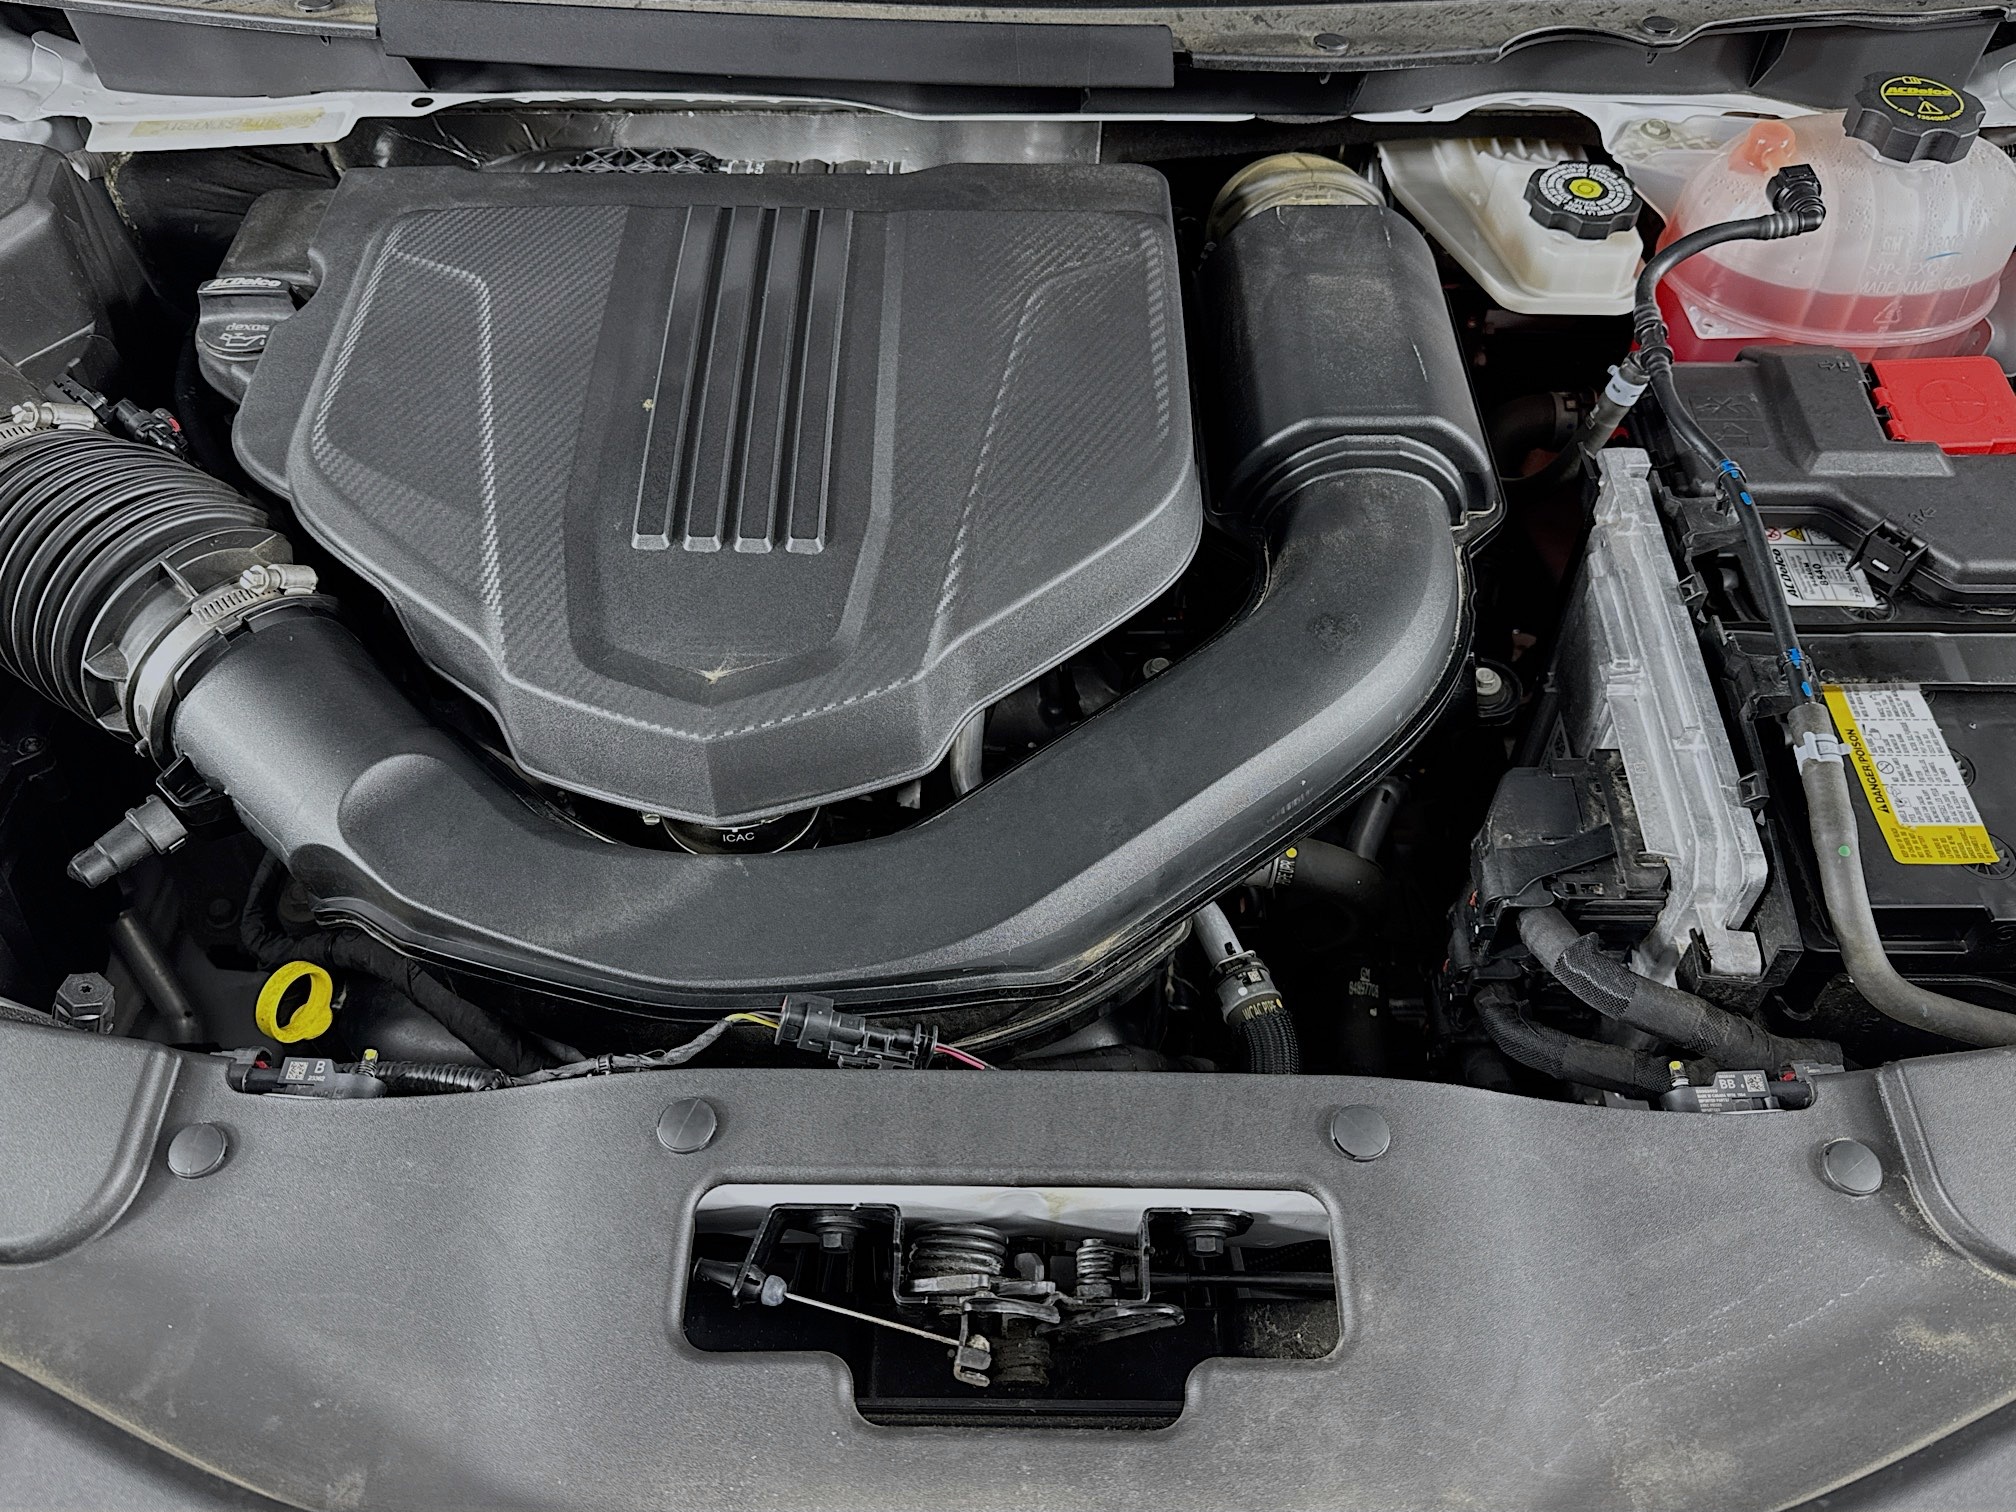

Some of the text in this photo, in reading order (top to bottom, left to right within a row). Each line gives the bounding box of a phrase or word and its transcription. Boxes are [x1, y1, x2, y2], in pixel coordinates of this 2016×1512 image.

[1885, 86, 1953, 96] ACDelco
[207, 277, 282, 288] ACDelco
[1911, 274, 1971, 293] MEXICO
[225, 322, 270, 331] dexos
[1772, 548, 1799, 598] ACDelco
[1813, 564, 1829, 586] 8540
[1852, 587, 1861, 598] 730
[1845, 729, 1886, 803] DANGER/POISON
[722, 832, 755, 842] ICAC
[314, 1060, 326, 1074] B
[1719, 1079, 1736, 1089] BB
